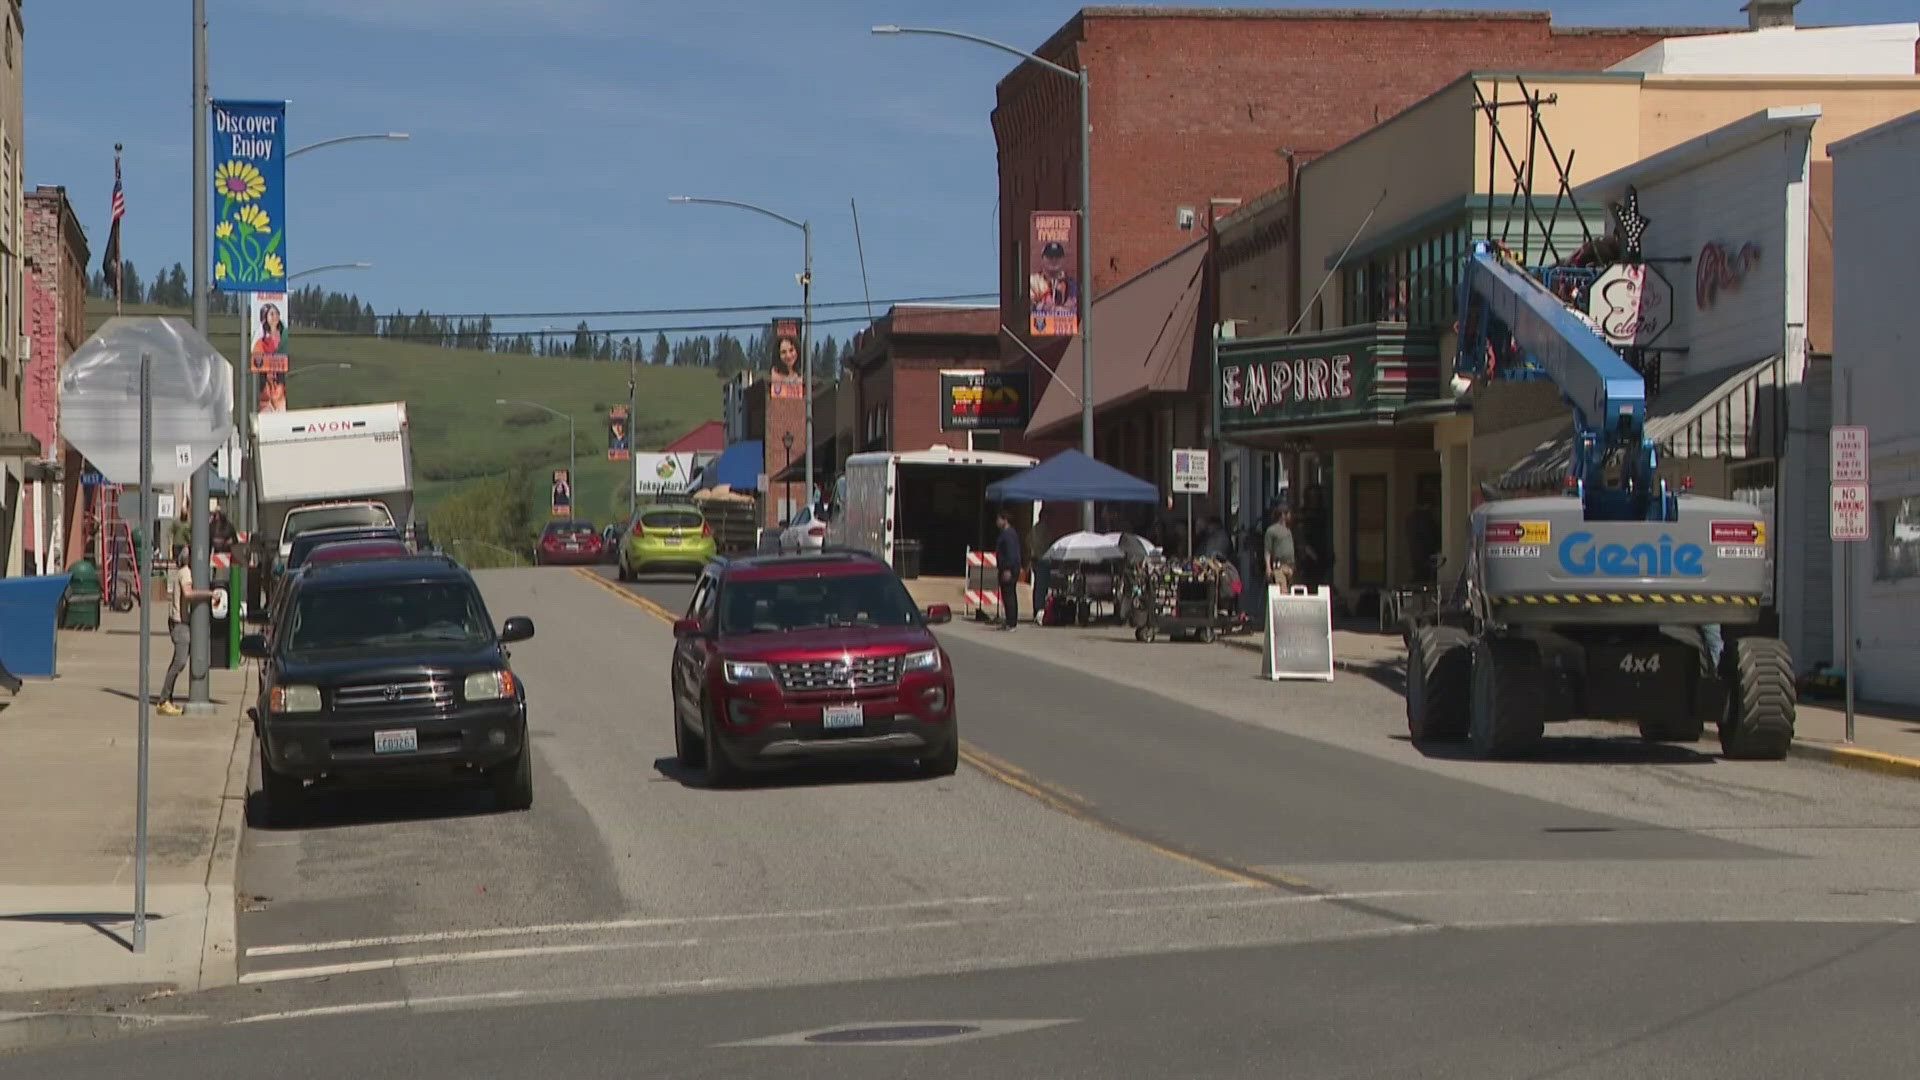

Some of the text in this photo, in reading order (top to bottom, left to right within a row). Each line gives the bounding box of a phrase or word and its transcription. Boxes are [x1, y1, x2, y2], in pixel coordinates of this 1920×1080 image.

[216, 108, 277, 133] Discover
[232, 133, 272, 160] Enjoy
[1222, 354, 1352, 416] EMPIRE
[307, 421, 351, 433] AVON
[1836, 441, 1861, 449] PARKING
[1842, 488, 1856, 499] NO
[1834, 500, 1864, 511] PARKING
[1839, 511, 1858, 519] HERE
[1835, 526, 1864, 534] CORNER
[1558, 531, 1704, 577] Genie
[1619, 653, 1661, 673] 4x4
